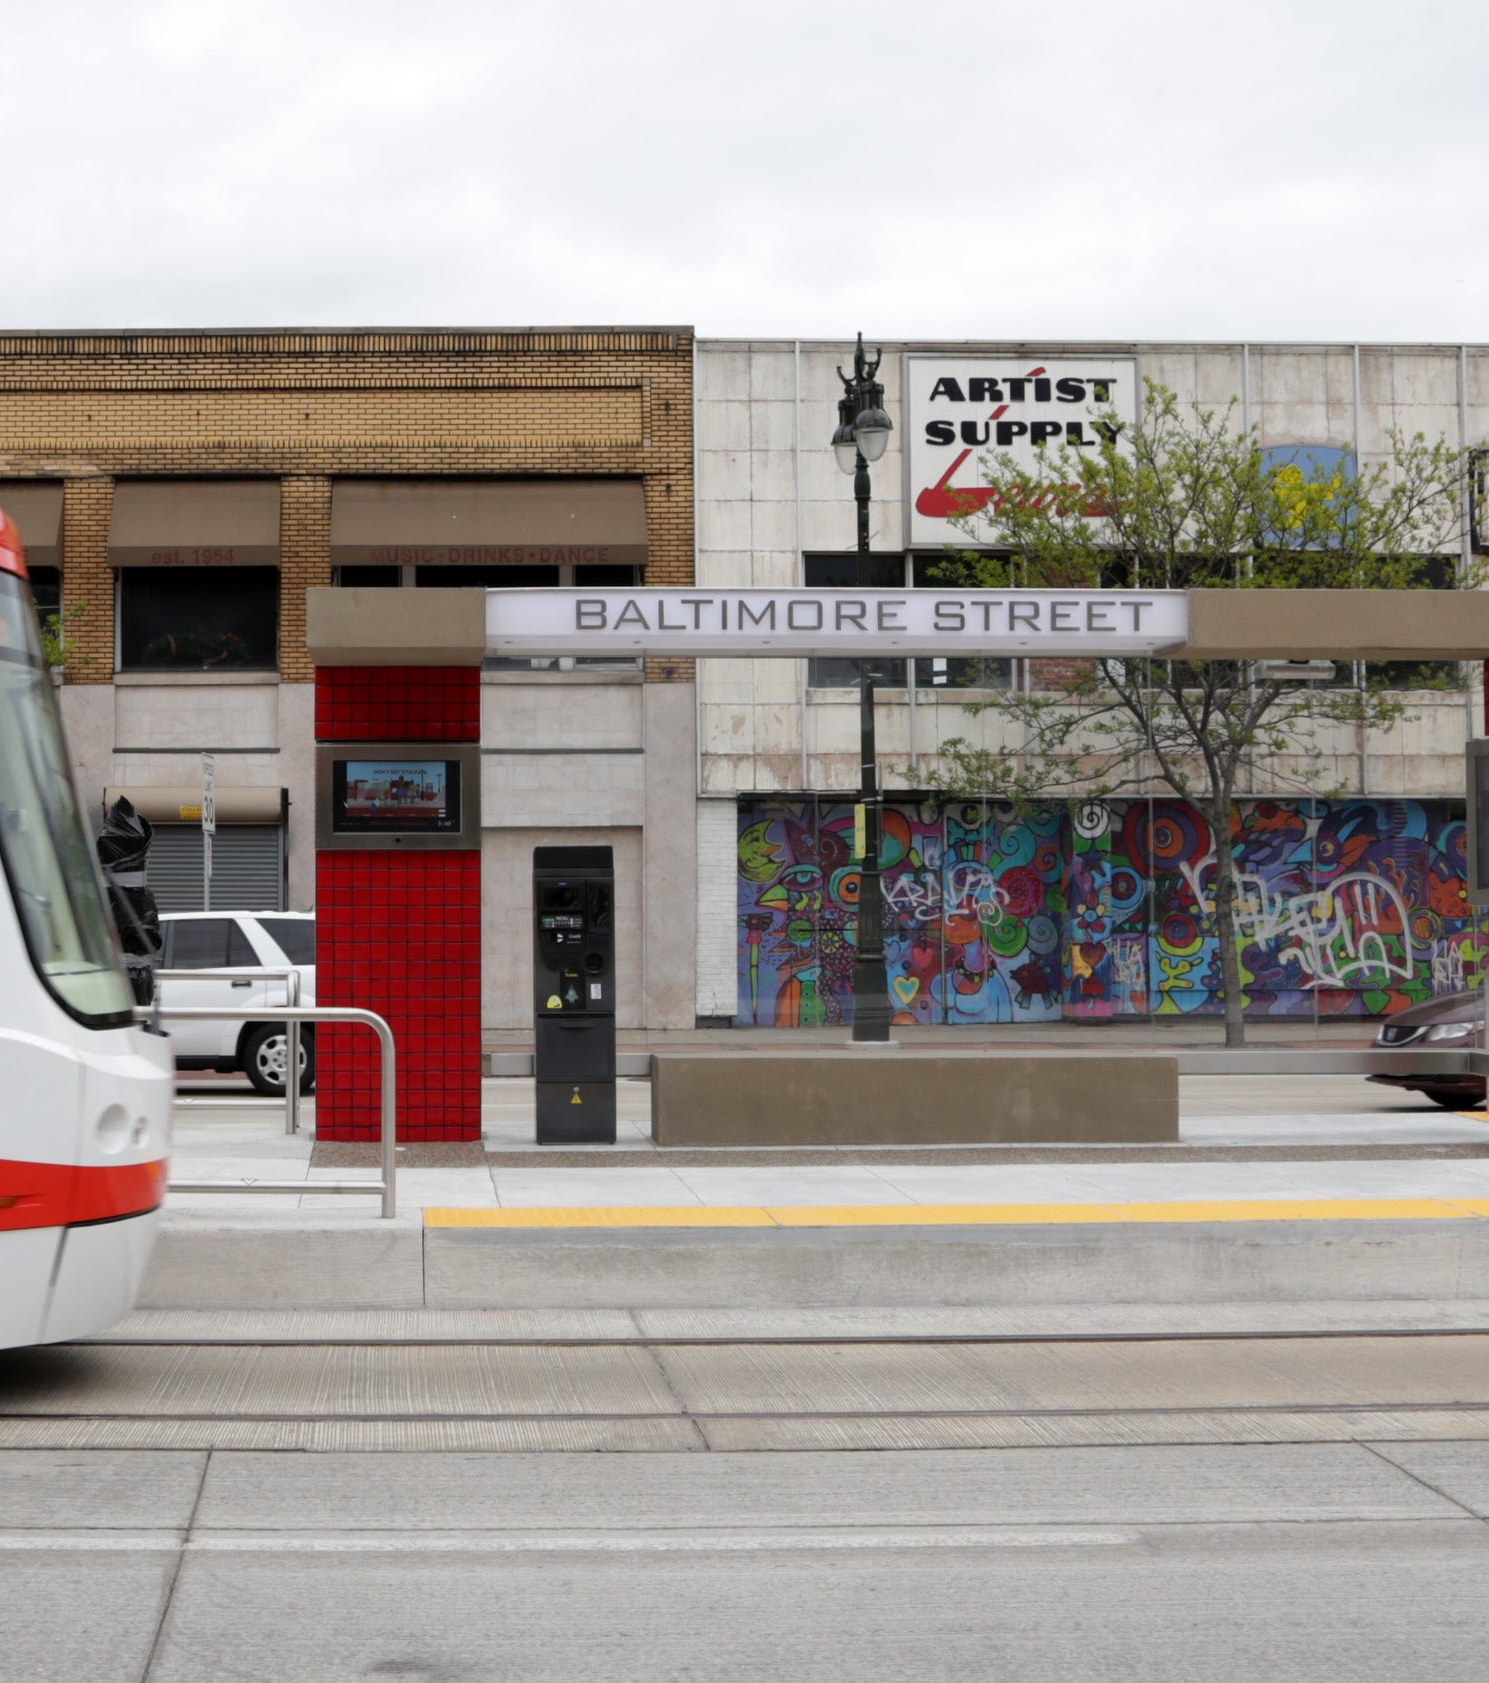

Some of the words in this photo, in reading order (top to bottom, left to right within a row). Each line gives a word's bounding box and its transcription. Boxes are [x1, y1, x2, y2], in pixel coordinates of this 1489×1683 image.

[929, 370, 1117, 403] ARTIST
[925, 416, 1122, 446] SUPPLY
[151, 550, 184, 565] est.
[192, 548, 235, 565] 1954
[369, 549, 433, 564] MUSIC
[447, 548, 526, 563] DRINKS
[539, 547, 610, 563] DANCE
[574, 598, 909, 633] BALTIMORE
[932, 599, 1155, 633] STREET
